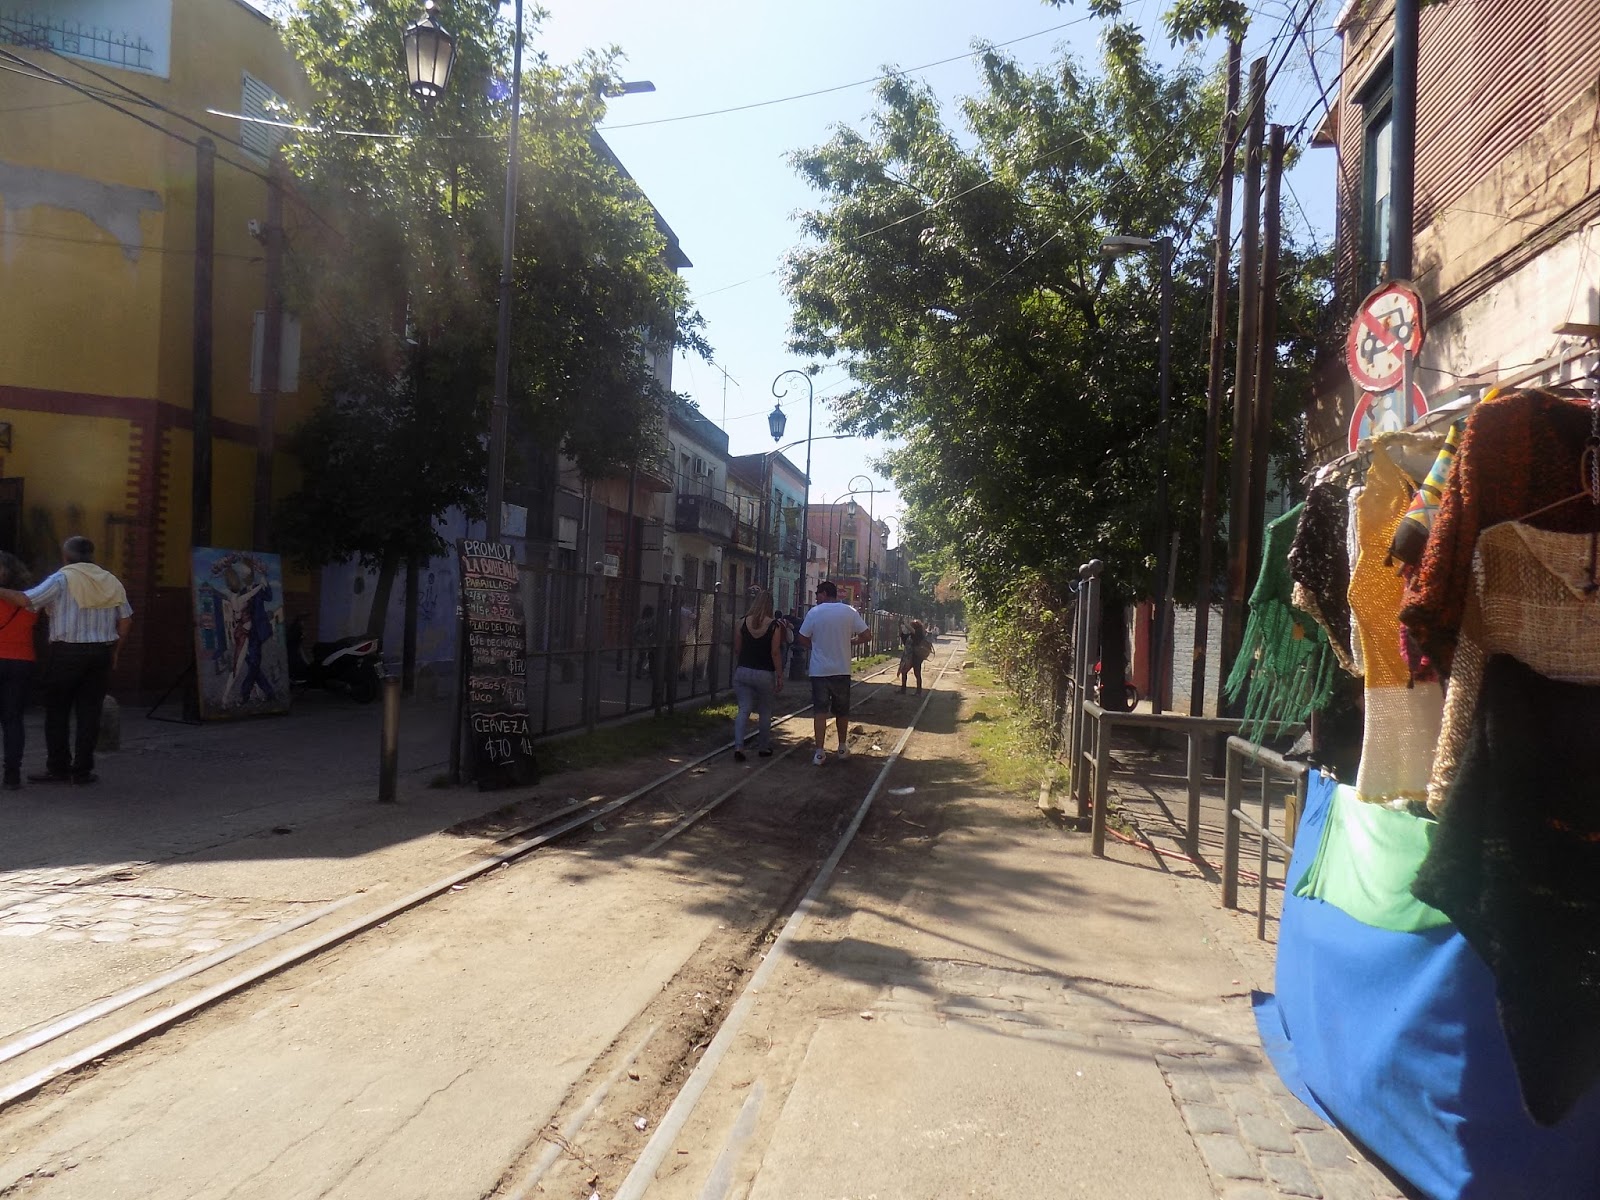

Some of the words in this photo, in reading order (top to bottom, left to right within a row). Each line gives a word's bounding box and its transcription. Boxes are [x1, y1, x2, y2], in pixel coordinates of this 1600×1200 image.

[463, 540, 512, 564] PROMO!
[491, 621, 504, 632] DEL
[469, 690, 493, 703] TUCO
[474, 718, 529, 735] CERVEZA
[484, 735, 512, 763] $70
